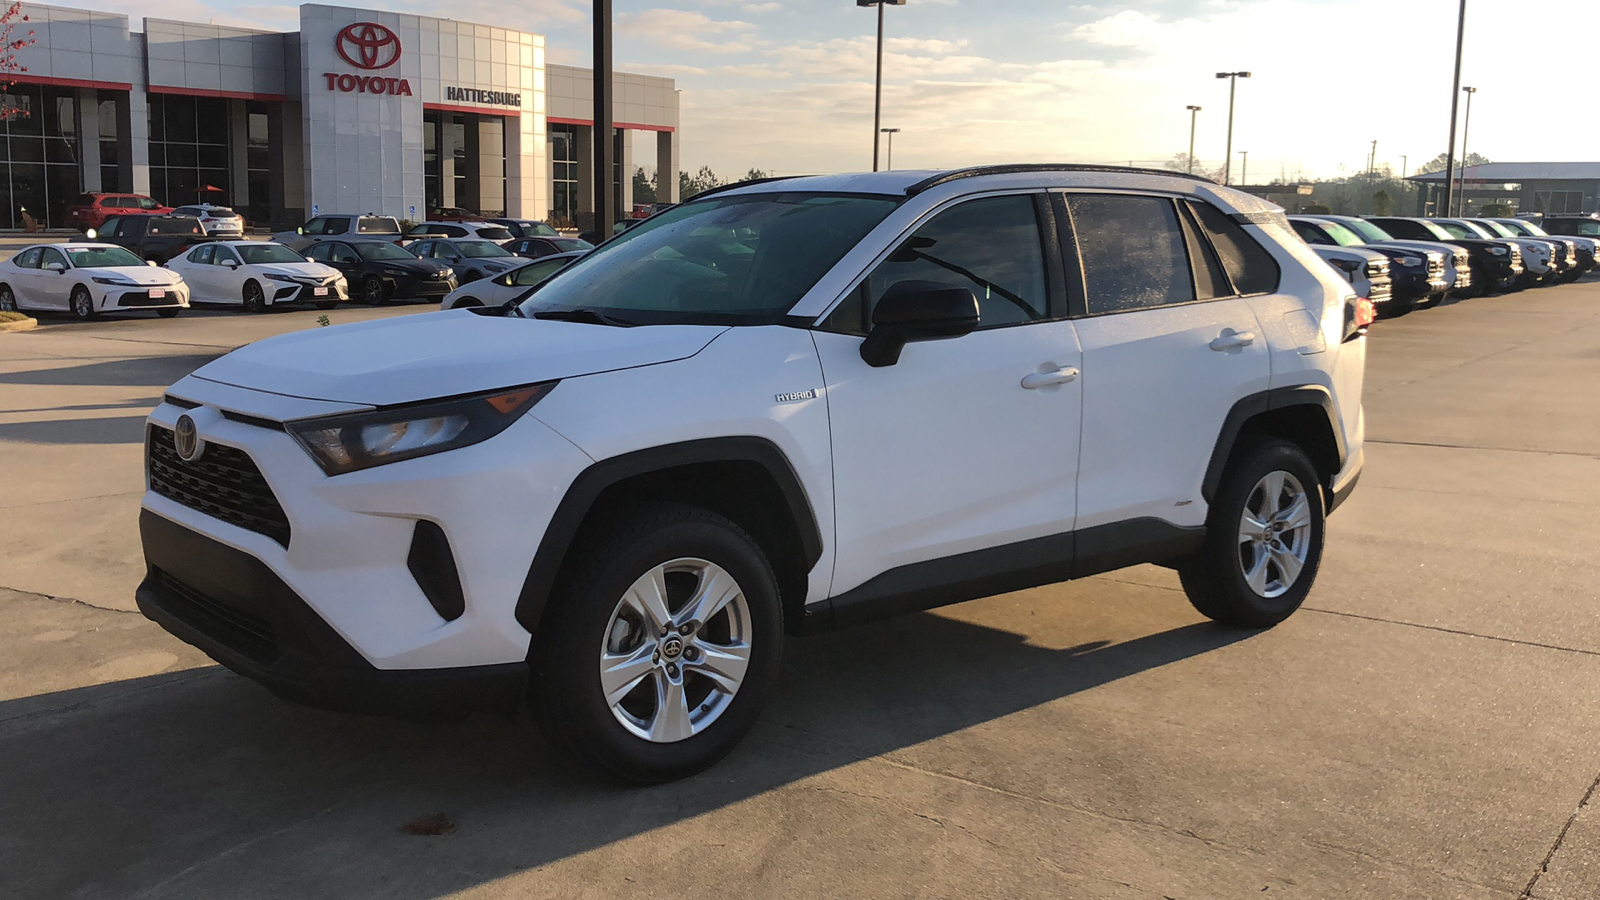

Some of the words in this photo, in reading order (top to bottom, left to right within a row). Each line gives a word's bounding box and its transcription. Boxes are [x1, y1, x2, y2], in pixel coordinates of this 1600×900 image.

[323, 72, 412, 96] TOYOTA
[447, 86, 521, 107] HATTIESBURG
[775, 390, 813, 402] HYBRID
